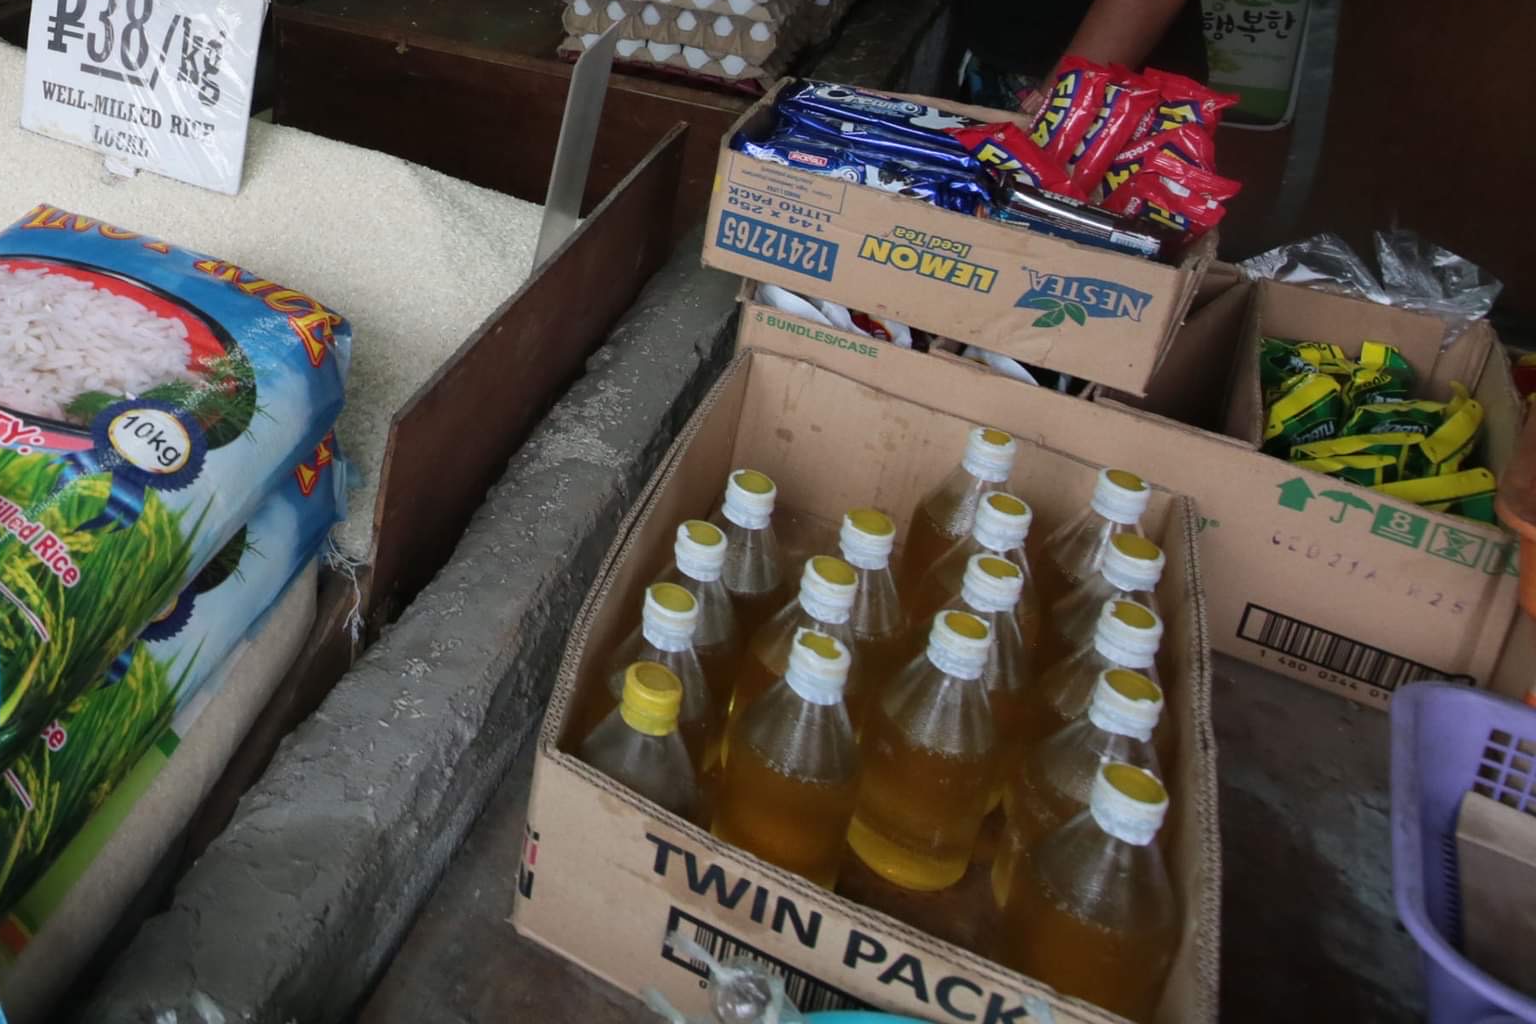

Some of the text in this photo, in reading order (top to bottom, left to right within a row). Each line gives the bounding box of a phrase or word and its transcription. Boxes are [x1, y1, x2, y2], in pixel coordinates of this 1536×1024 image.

[1029, 72, 1078, 150] FITA
[727, 185, 833, 224] LITRO PACK
[727, 194, 764, 215] 25g
[786, 212, 826, 233] 144
[721, 215, 833, 276] 12412765
[860, 234, 999, 294] LEMON
[892, 225, 971, 260] Iced Tea
[1027, 268, 1152, 324] NESTEA
[755, 310, 880, 360] 5 BUNDLES/CASE
[120, 413, 182, 468] 10kg
[1388, 511, 1413, 533] 8
[28, 525, 81, 588] Rice
[645, 830, 1030, 1024] TWIN PACK
